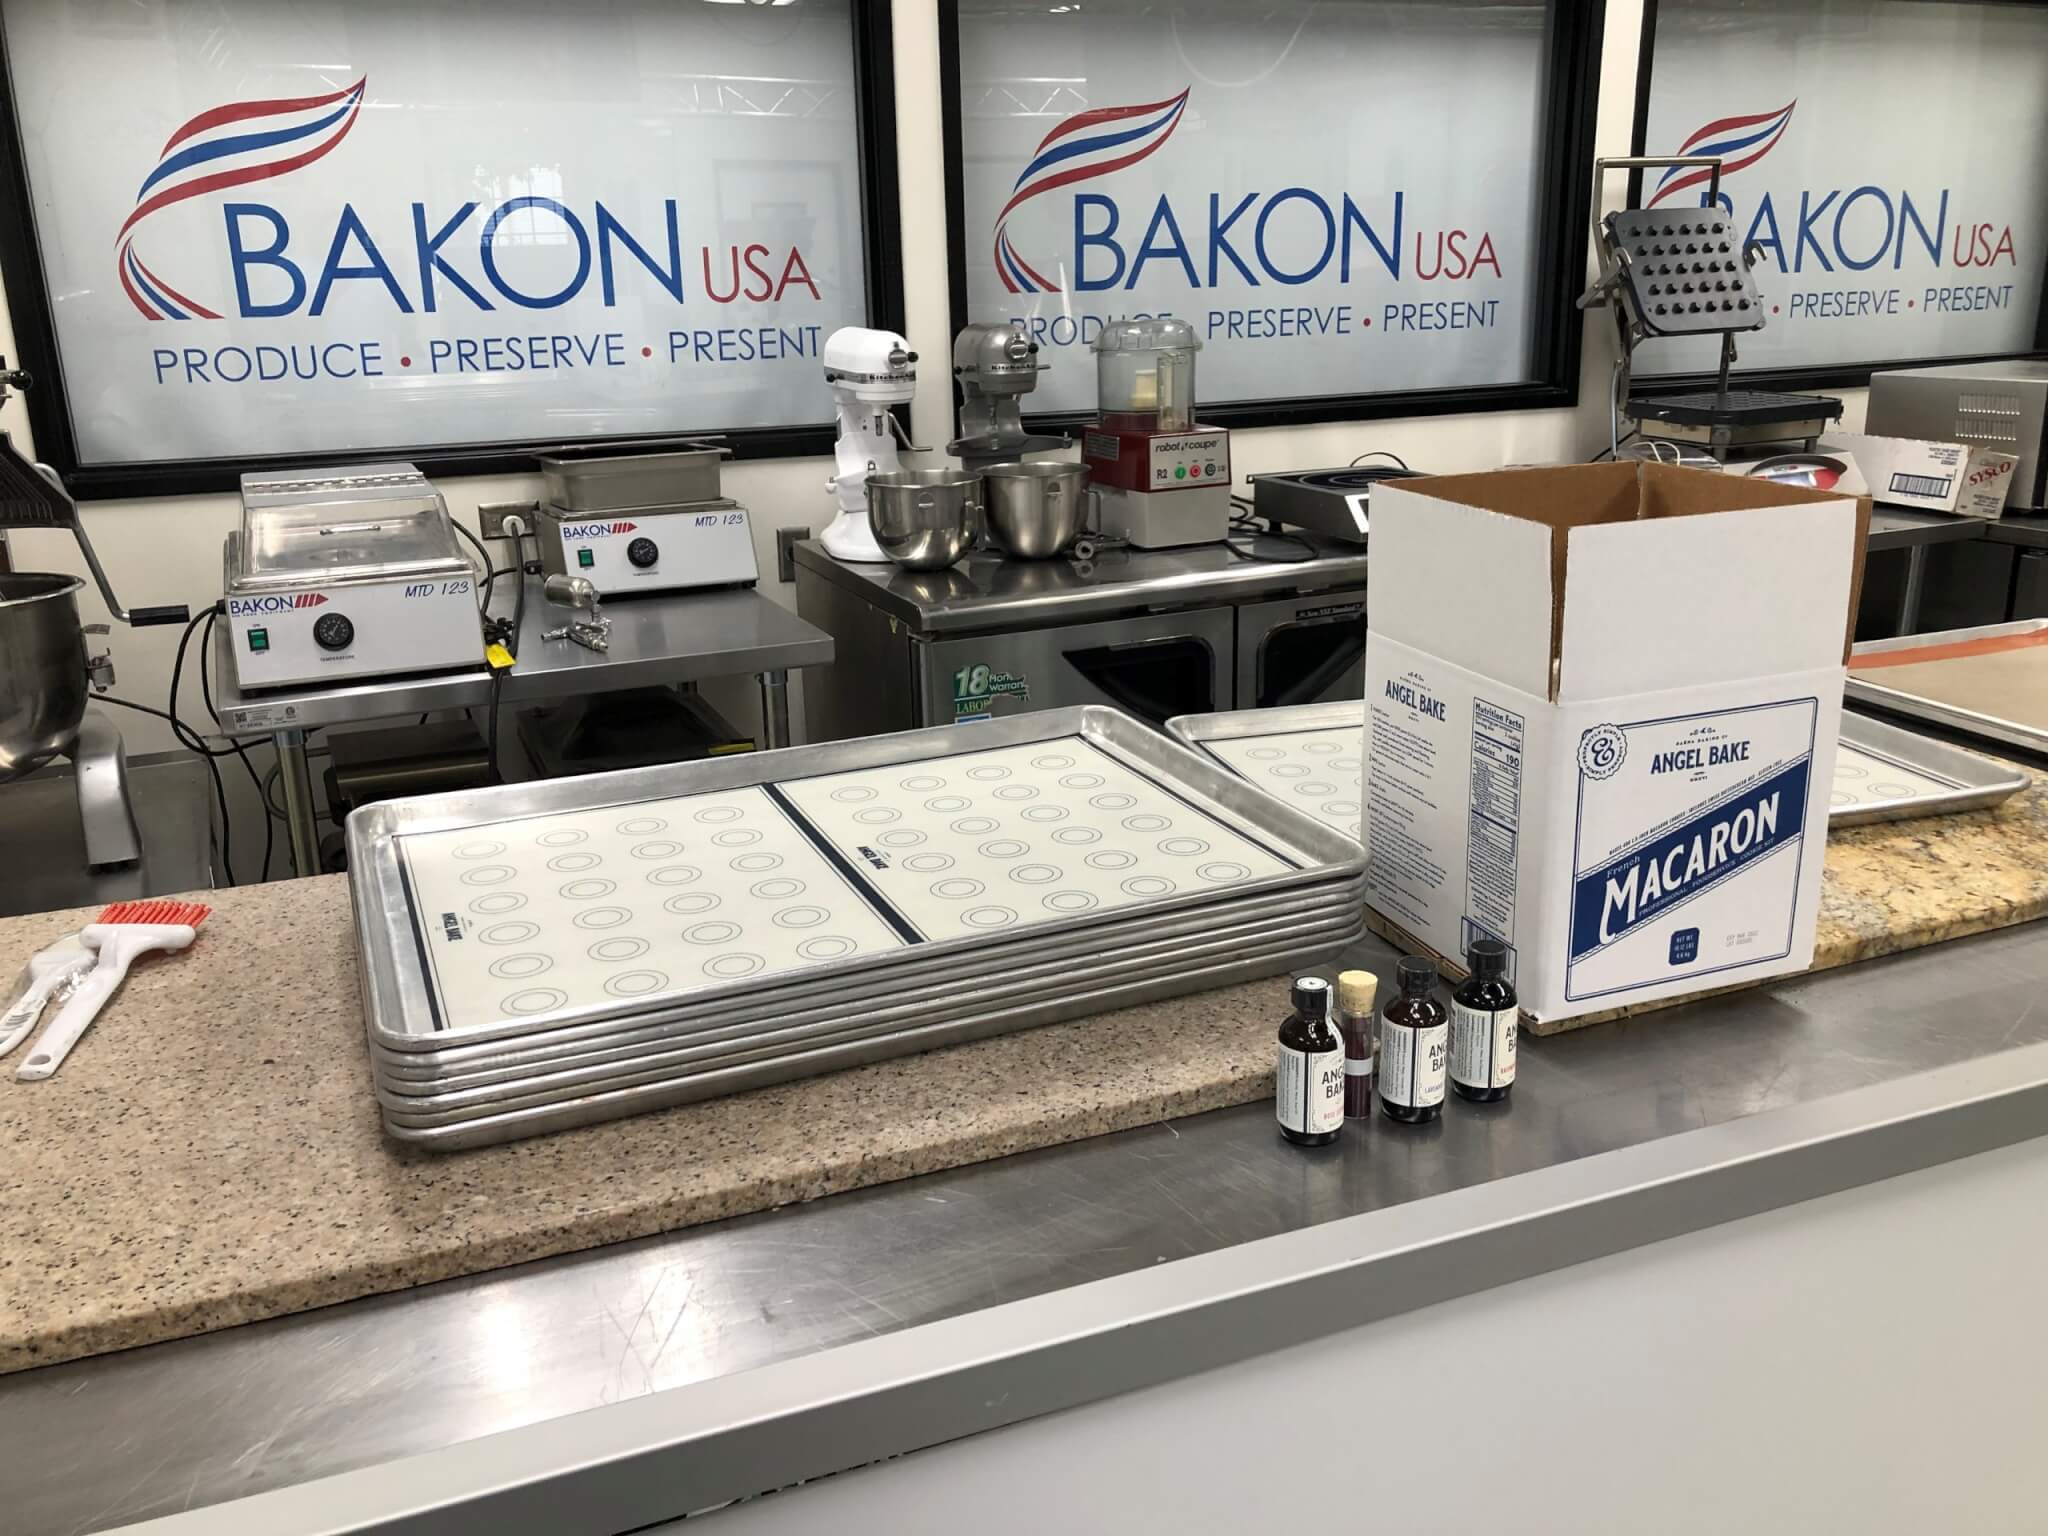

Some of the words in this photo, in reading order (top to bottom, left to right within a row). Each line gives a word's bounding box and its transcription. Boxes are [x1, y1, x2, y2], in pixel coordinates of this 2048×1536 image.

[1074, 187, 1404, 292] BAKON
[1416, 231, 1502, 280] USA
[1953, 223, 2016, 268] USA
[223, 195, 684, 319] BAKON
[703, 245, 822, 304] USA
[1789, 288, 1899, 318] PRESERVE
[1923, 284, 2013, 313] PRESENT
[1208, 306, 1352, 340] PRESERVE
[1383, 300, 1499, 333] PRESENT
[153, 341, 384, 384] PRODUCE
[430, 333, 625, 374] PRESERVE
[668, 325, 822, 364] PRESENT
[1156, 469, 1168, 480] R2
[1968, 461, 2011, 487] SYSCO
[563, 523, 611, 538] BAKON
[695, 515, 718, 527] MTD
[230, 596, 294, 614] BAKON
[405, 584, 434, 598] MTD
[441, 581, 470, 595] 123
[955, 664, 990, 697] 18
[989, 681, 1024, 692] Warran
[1385, 679, 1417, 710] ANGEL
[1419, 694, 1446, 722] BAKE
[1506, 754, 1519, 768] 190
[1650, 749, 1705, 775] ANGEL
[1709, 741, 1750, 766] BAKE
[1599, 791, 1780, 945] MACARON
[1607, 855, 1640, 878] French
[1322, 1065, 1344, 1085] ANG
[1326, 1080, 1344, 1099] BAK
